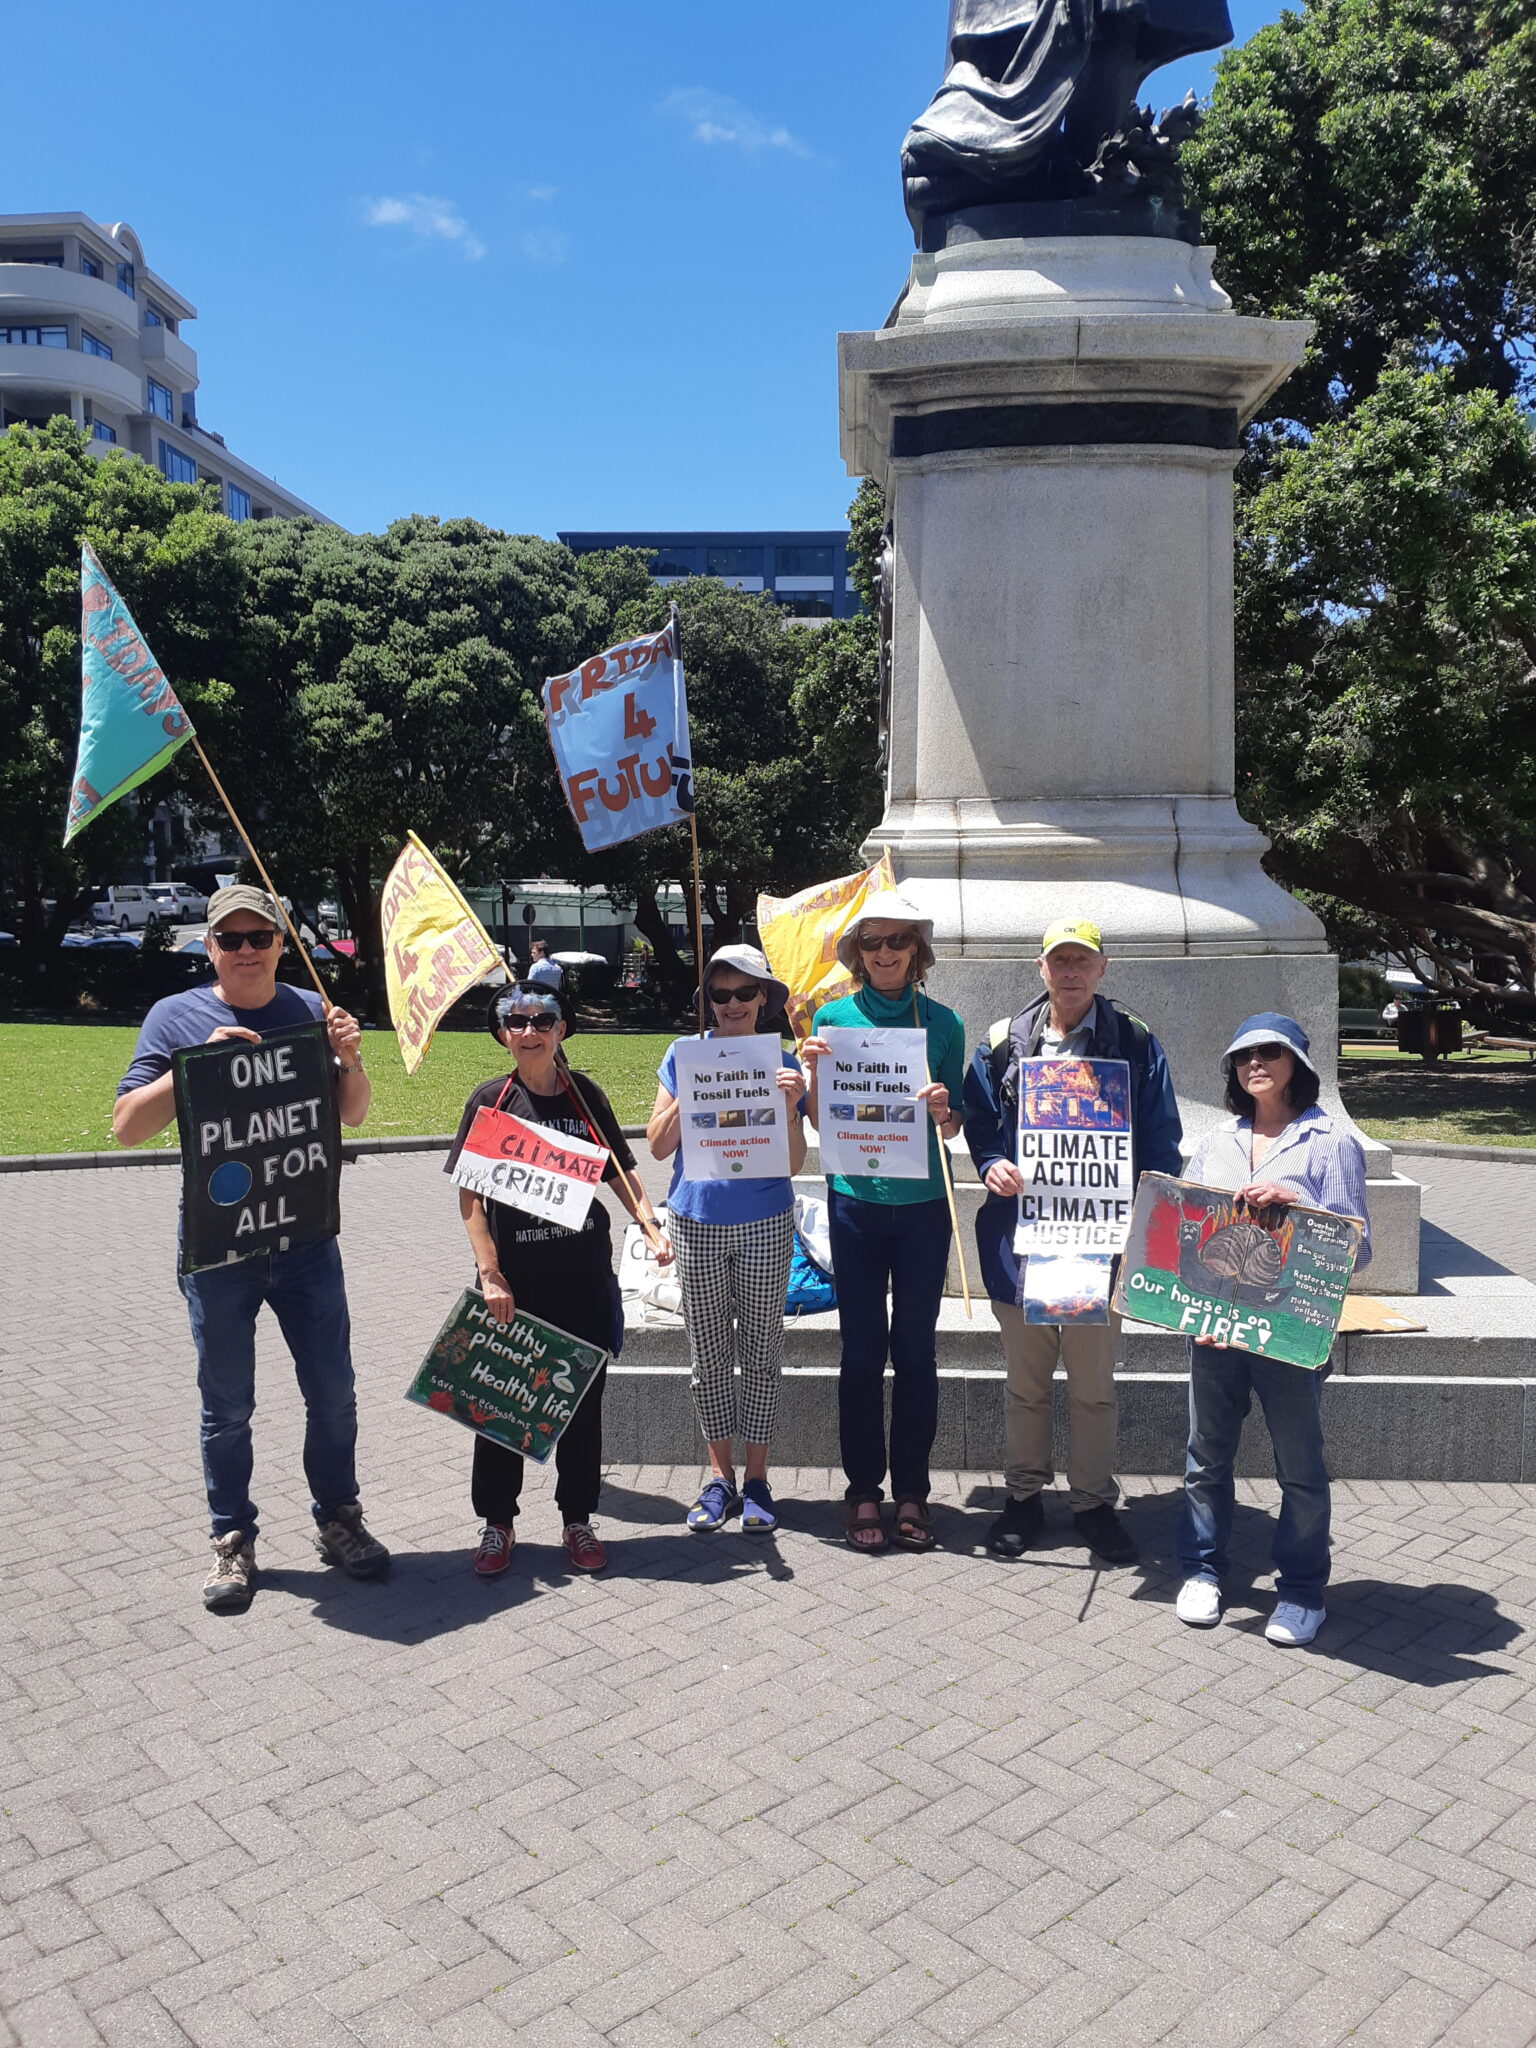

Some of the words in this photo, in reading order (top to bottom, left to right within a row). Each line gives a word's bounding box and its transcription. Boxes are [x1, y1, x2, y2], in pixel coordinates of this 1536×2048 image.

[549, 628, 674, 713] FRIDA
[624, 692, 657, 740] 4
[567, 742, 674, 823] FUTU
[393, 940, 419, 985] 4
[398, 920, 491, 1048] UTURE
[231, 1045, 297, 1088] ONE
[694, 1072, 712, 1084] No
[716, 1069, 749, 1082] Faith
[753, 1068, 766, 1079] in
[836, 1061, 852, 1073] No
[857, 1061, 890, 1074] Faith
[894, 1062, 908, 1074] in
[693, 1088, 731, 1100] Fossil
[735, 1086, 770, 1098] Fuels
[833, 1080, 870, 1092] Fossil
[875, 1081, 911, 1094] Fuels
[201, 1098, 321, 1156] PLANET
[837, 1131, 874, 1141] Climate
[876, 1133, 908, 1142] action
[700, 1138, 738, 1148] Climate
[740, 1136, 770, 1146] action
[722, 1150, 749, 1158] NOW!
[859, 1145, 886, 1154] NOW!
[1023, 1133, 1128, 1161] CLIMATE
[263, 1142, 328, 1185] FOR
[1032, 1160, 1119, 1188] ACTION
[235, 1195, 297, 1238] ALL
[1022, 1195, 1128, 1224] CLIMATE
[515, 1227, 550, 1243] NATURE
[1025, 1222, 1124, 1245] JUSTICE
[1318, 1234, 1348, 1249] farming
[1298, 1244, 1312, 1255] Ban
[1294, 1269, 1326, 1286] Restore
[1330, 1282, 1344, 1292] our
[1296, 1280, 1343, 1301] ecosystems
[1130, 1272, 1166, 1294] Our
[1171, 1284, 1223, 1315] house
[1228, 1304, 1240, 1320] is
[1248, 1316, 1271, 1330] on
[1290, 1296, 1311, 1307] Make
[466, 1304, 548, 1358] Healthy
[1179, 1306, 1273, 1353] FIRE!
[470, 1361, 539, 1413] Healthy
[542, 1393, 572, 1422] life
[460, 1390, 478, 1400] our
[478, 1398, 532, 1430] ecosystems
